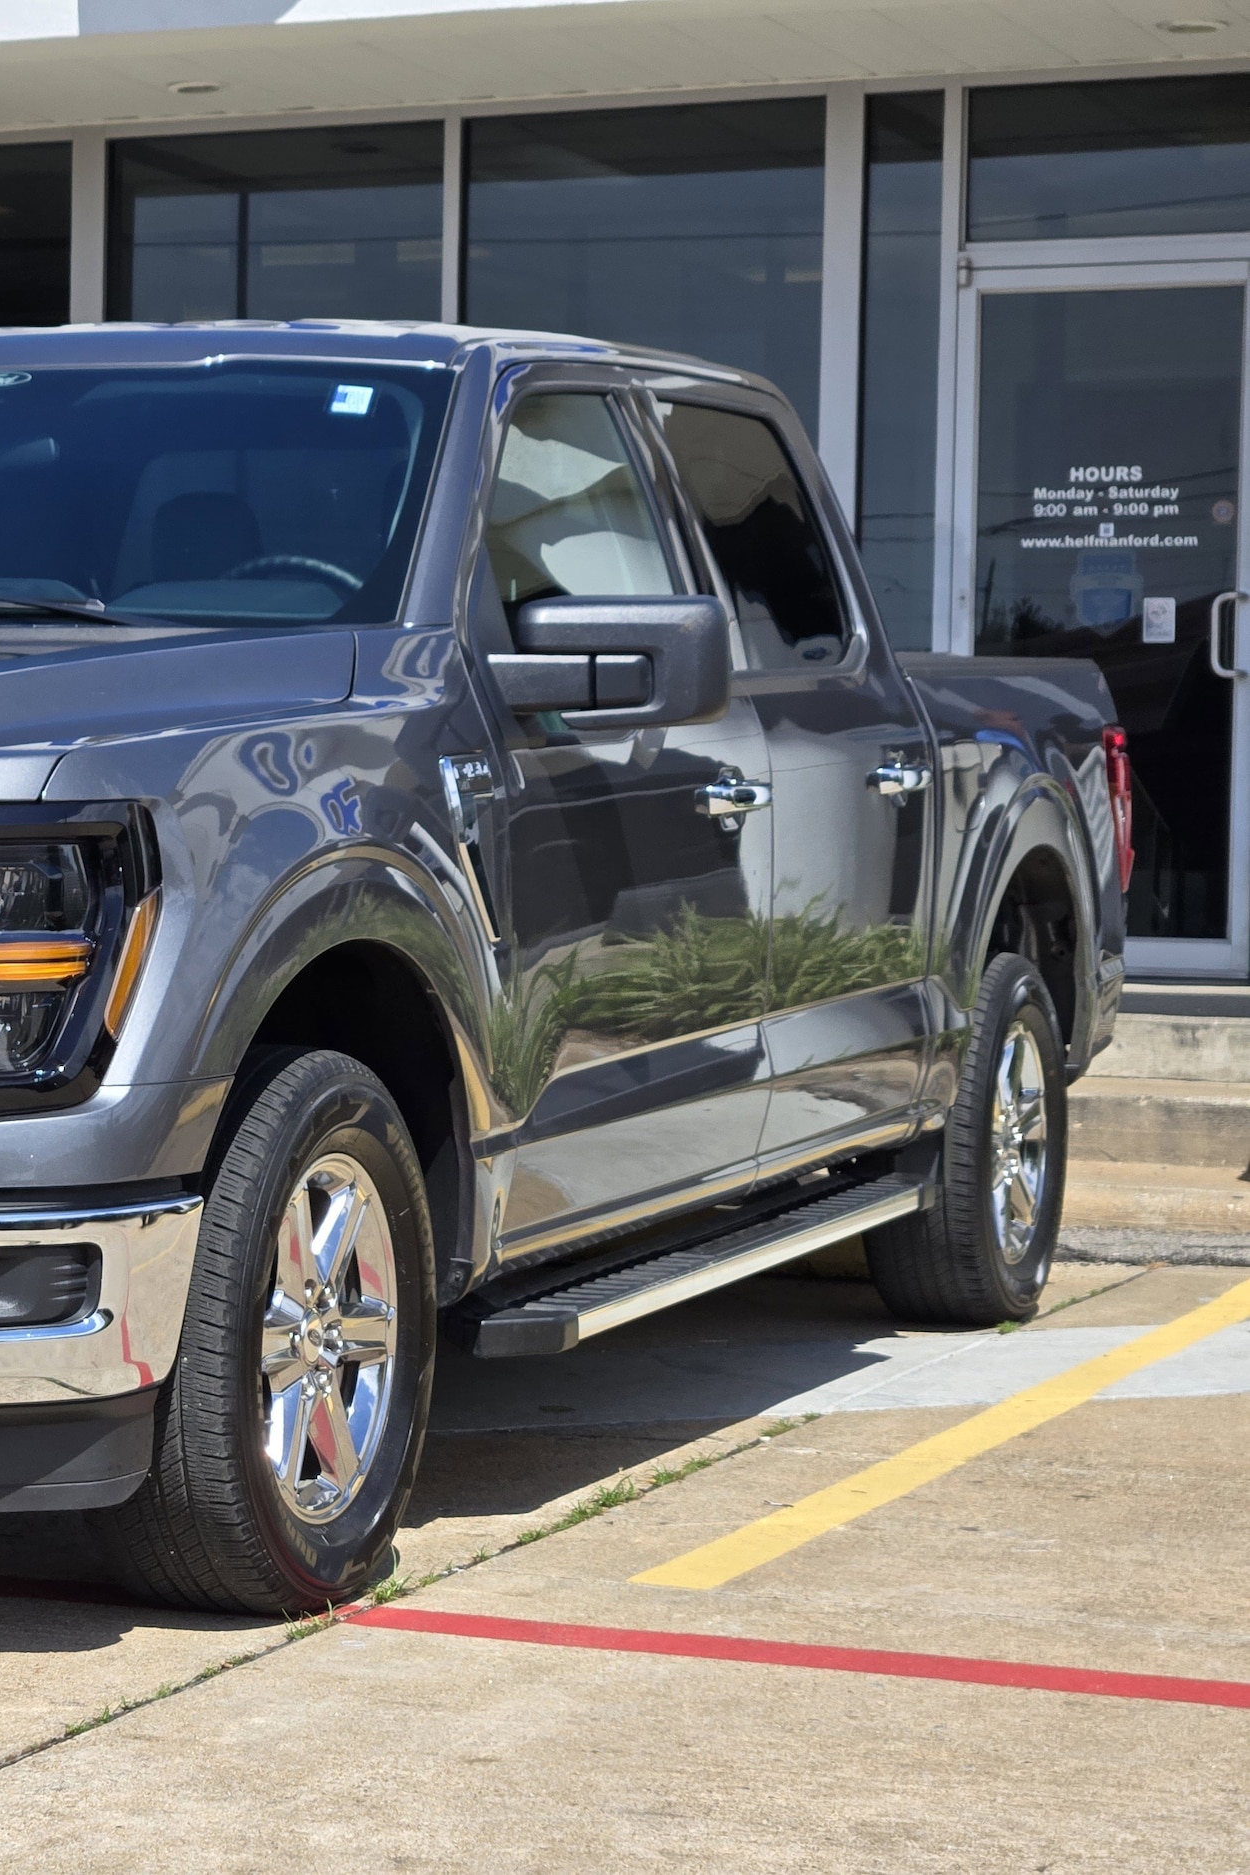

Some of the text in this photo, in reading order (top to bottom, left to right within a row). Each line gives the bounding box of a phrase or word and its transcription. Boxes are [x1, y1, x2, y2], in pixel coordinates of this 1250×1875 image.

[1069, 465, 1143, 482] HOURS
[1033, 487, 1094, 502] Monday
[1108, 485, 1179, 501] Saturday
[1033, 503, 1067, 517] 9:00
[1072, 505, 1098, 516] am
[1113, 503, 1149, 516] 9:00
[1153, 503, 1180, 518] pm
[1020, 534, 1198, 548] www.helfmanford.com
